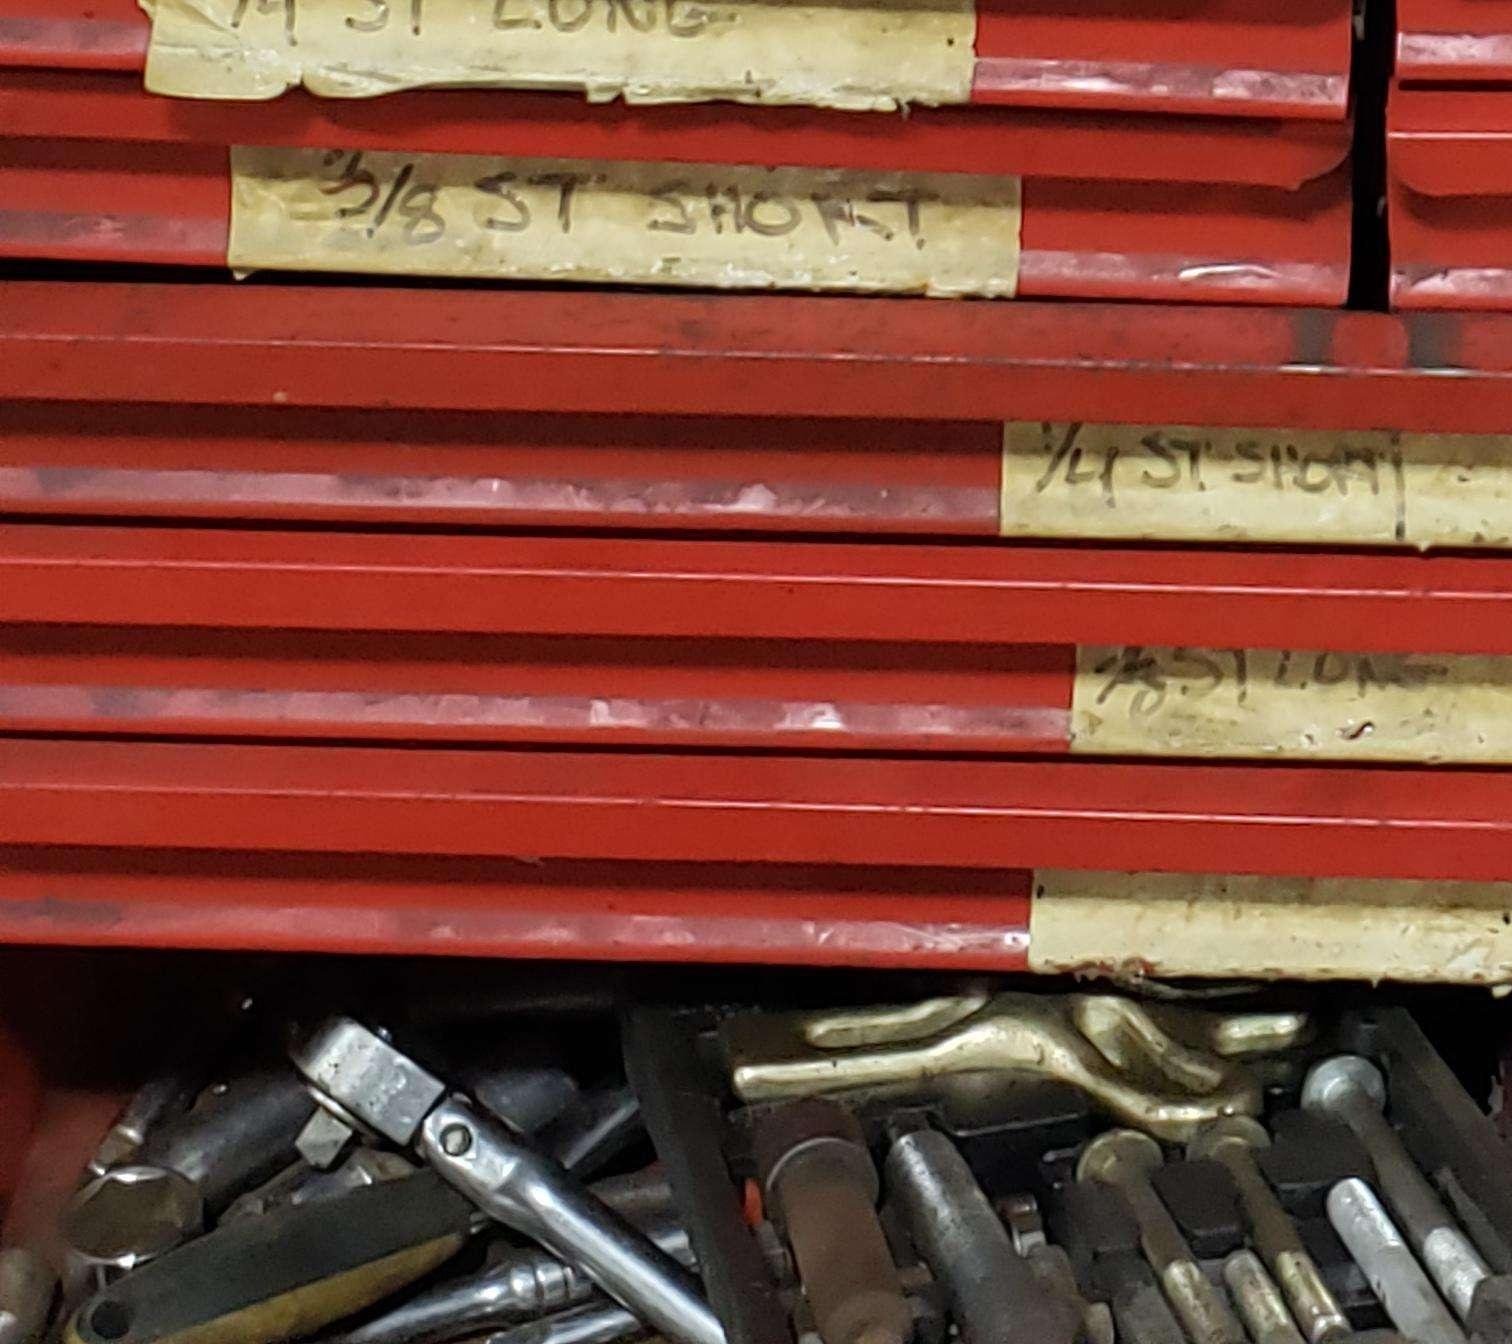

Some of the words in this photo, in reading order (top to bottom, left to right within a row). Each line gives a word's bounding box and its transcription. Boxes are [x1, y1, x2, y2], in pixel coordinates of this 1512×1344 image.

[321, 148, 447, 245] 3/8
[474, 172, 608, 234] ST
[645, 183, 941, 249] SHORT
[1034, 422, 1120, 509] 1/4
